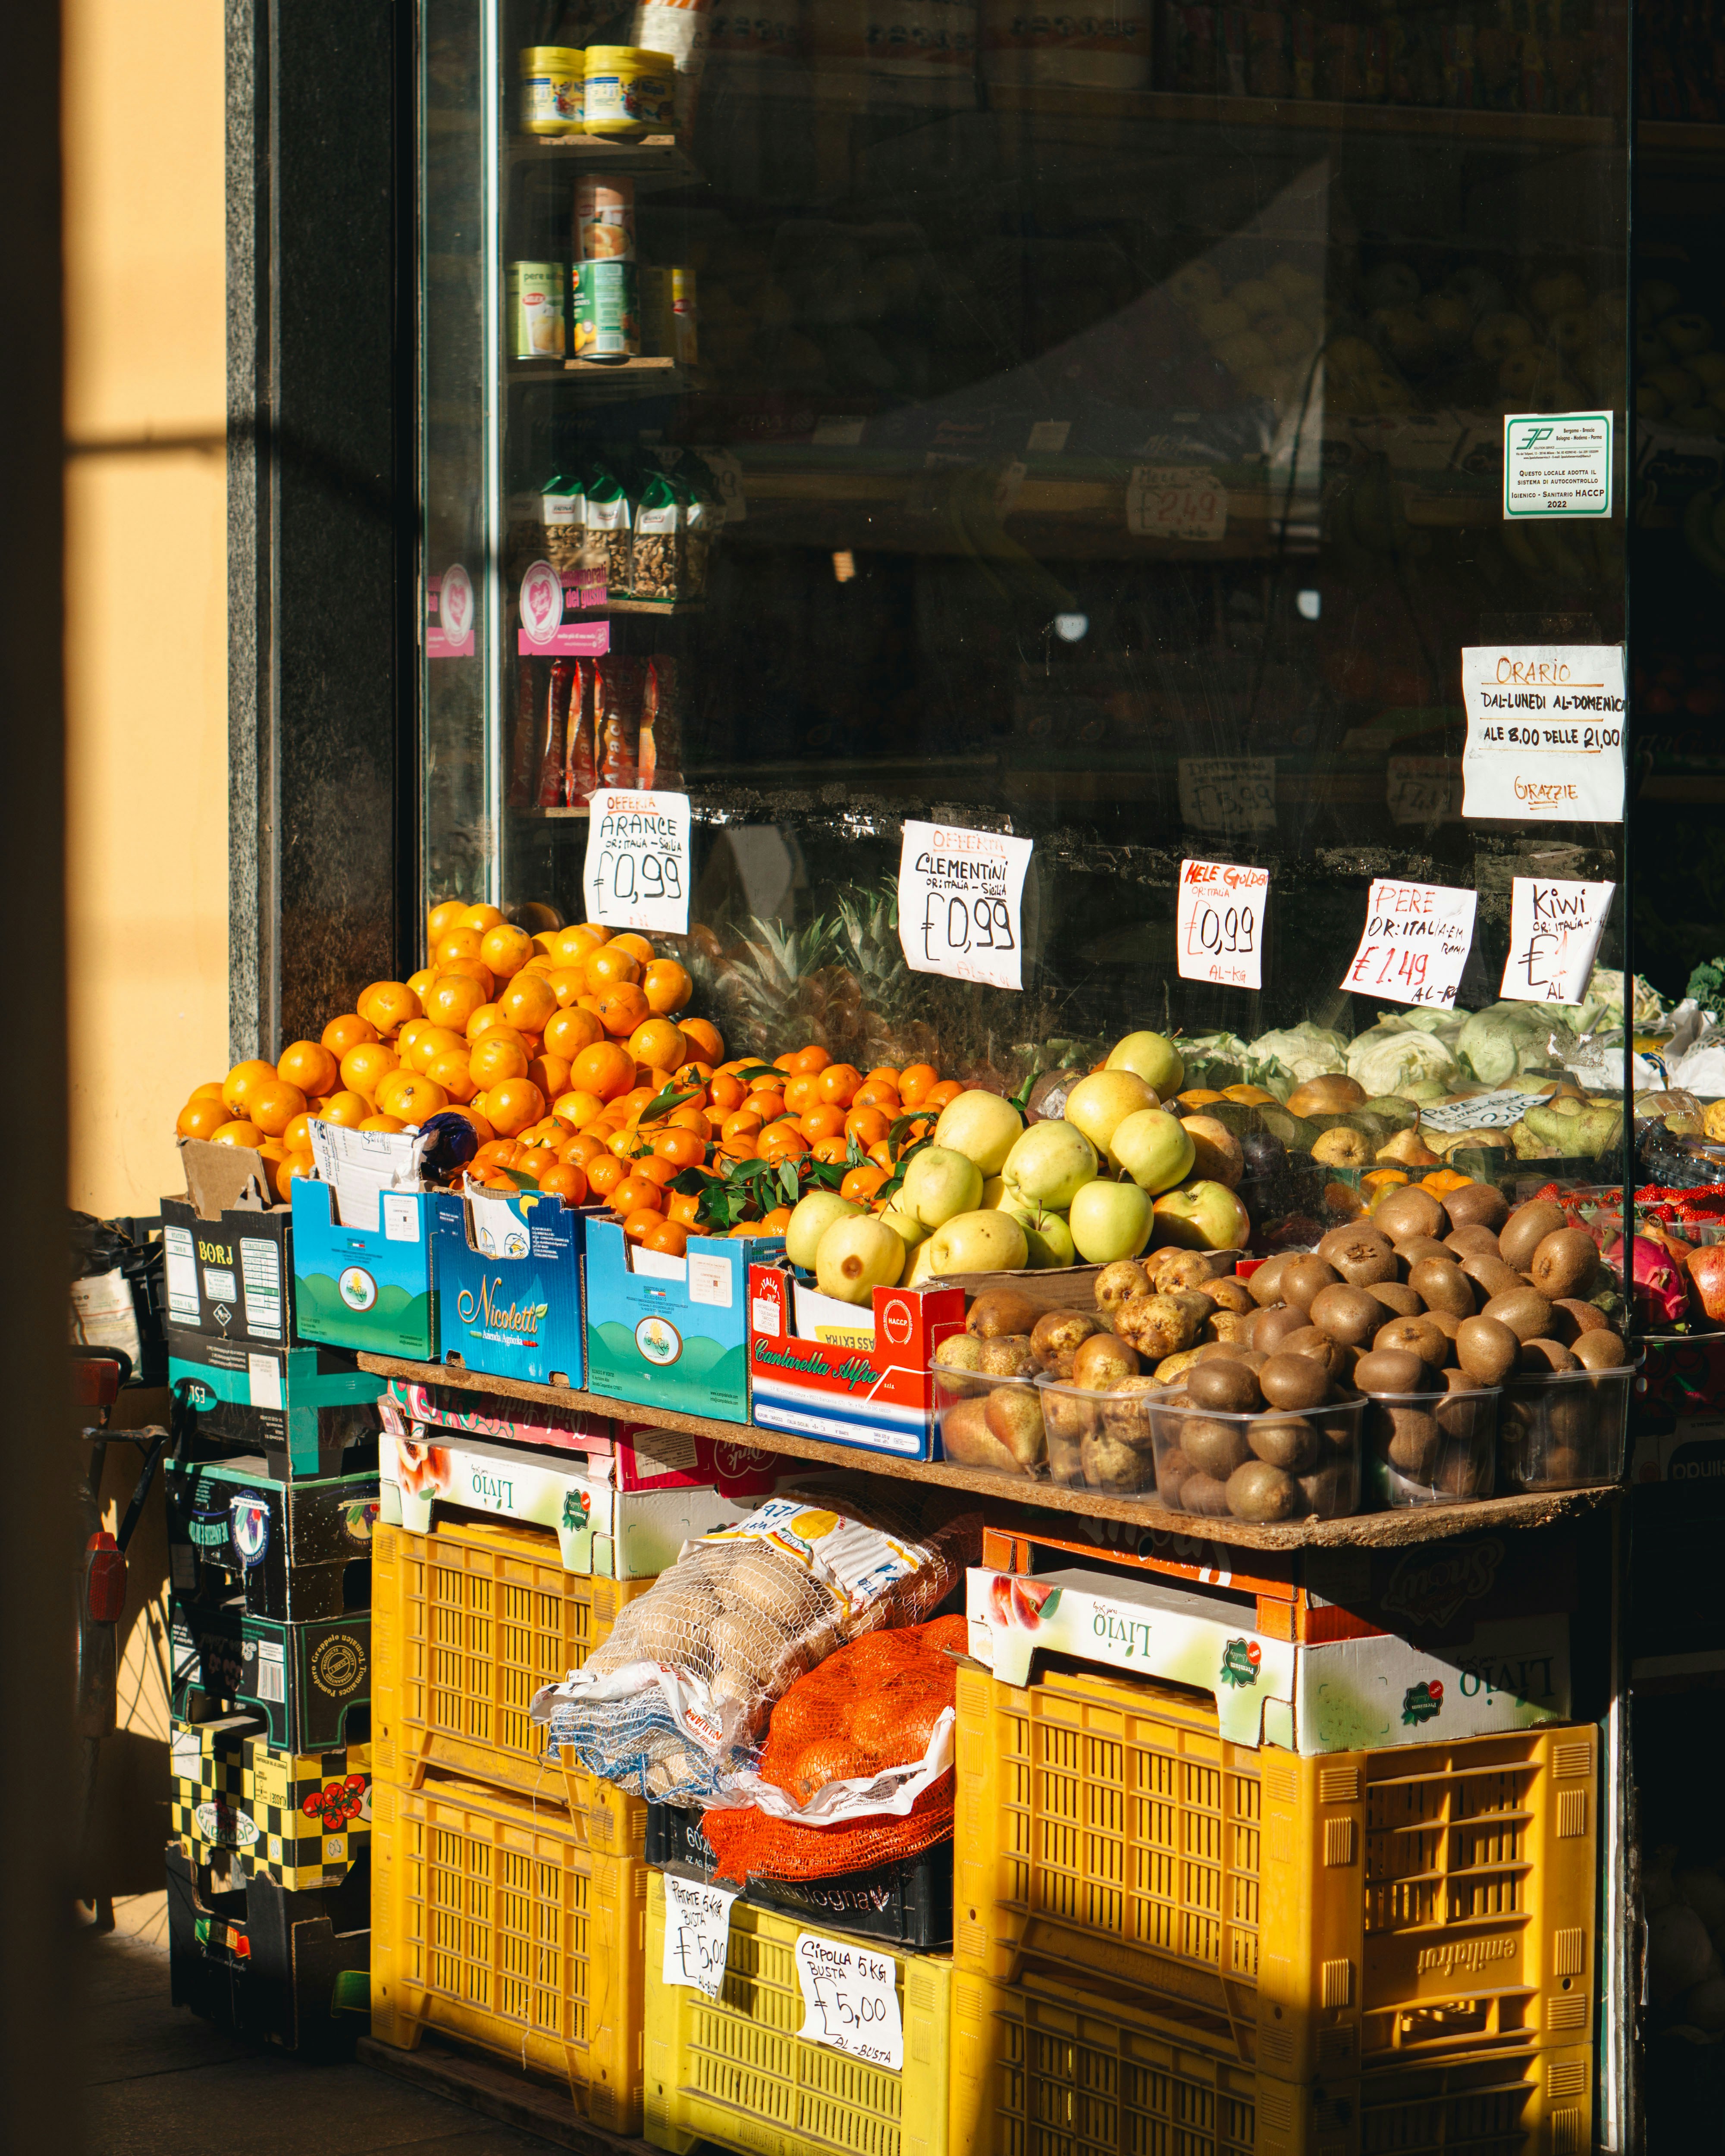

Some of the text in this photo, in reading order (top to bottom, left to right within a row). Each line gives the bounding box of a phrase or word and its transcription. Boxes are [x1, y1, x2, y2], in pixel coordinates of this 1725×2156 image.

[566, 588, 579, 608] del
[581, 586, 607, 609] gusto!
[1496, 655, 1570, 685] ORARIO
[1481, 692, 1546, 710] DAL-LUNEDI
[1484, 727, 1504, 741] ALE
[1543, 729, 1578, 744] DELLE
[607, 796, 656, 810] OFFERTA
[601, 814, 677, 837] ARANCE
[933, 830, 1004, 852] OFFERTA
[1375, 884, 1436, 914] PERE
[1546, 981, 1565, 1000] AL
[1421, 1100, 1475, 1120] PERE
[198, 1241, 233, 1265] BORJ
[761, 1277, 778, 1293] ITALIA
[458, 1274, 538, 1333] Nicoletti
[483, 1329, 523, 1347] Azienda Agricola
[825, 1334, 855, 1349] EXTRA
[754, 1337, 883, 1391] Cantarella Alfio
[473, 1474, 514, 1509] Livio
[569, 1509, 586, 1520] Premium
[778, 1531, 803, 1548] ITALY
[1093, 1614, 1152, 1658] Livio
[311, 1634, 339, 1663] Grappolo
[342, 1635, 366, 1664] Tomaten
[1230, 1648, 1248, 1663] Quality
[1249, 1649, 1260, 1658] 100%
[323, 1648, 354, 1670] PRODUCTS QUALITY
[1230, 1662, 1254, 1674] Premium
[311, 1665, 367, 1697] Pomodoro Tomatoes
[1430, 1684, 1442, 1695] 100%
[1460, 1657, 1556, 1707] Livio
[1411, 1701, 1437, 1711] Premium
[272, 1793, 286, 1807] KLASSE
[672, 1880, 700, 1905] PATATE
[681, 1909, 706, 1927] BUSTA
[802, 1940, 852, 1965] CIPOLLA
[807, 1961, 847, 1980] BUSTA
